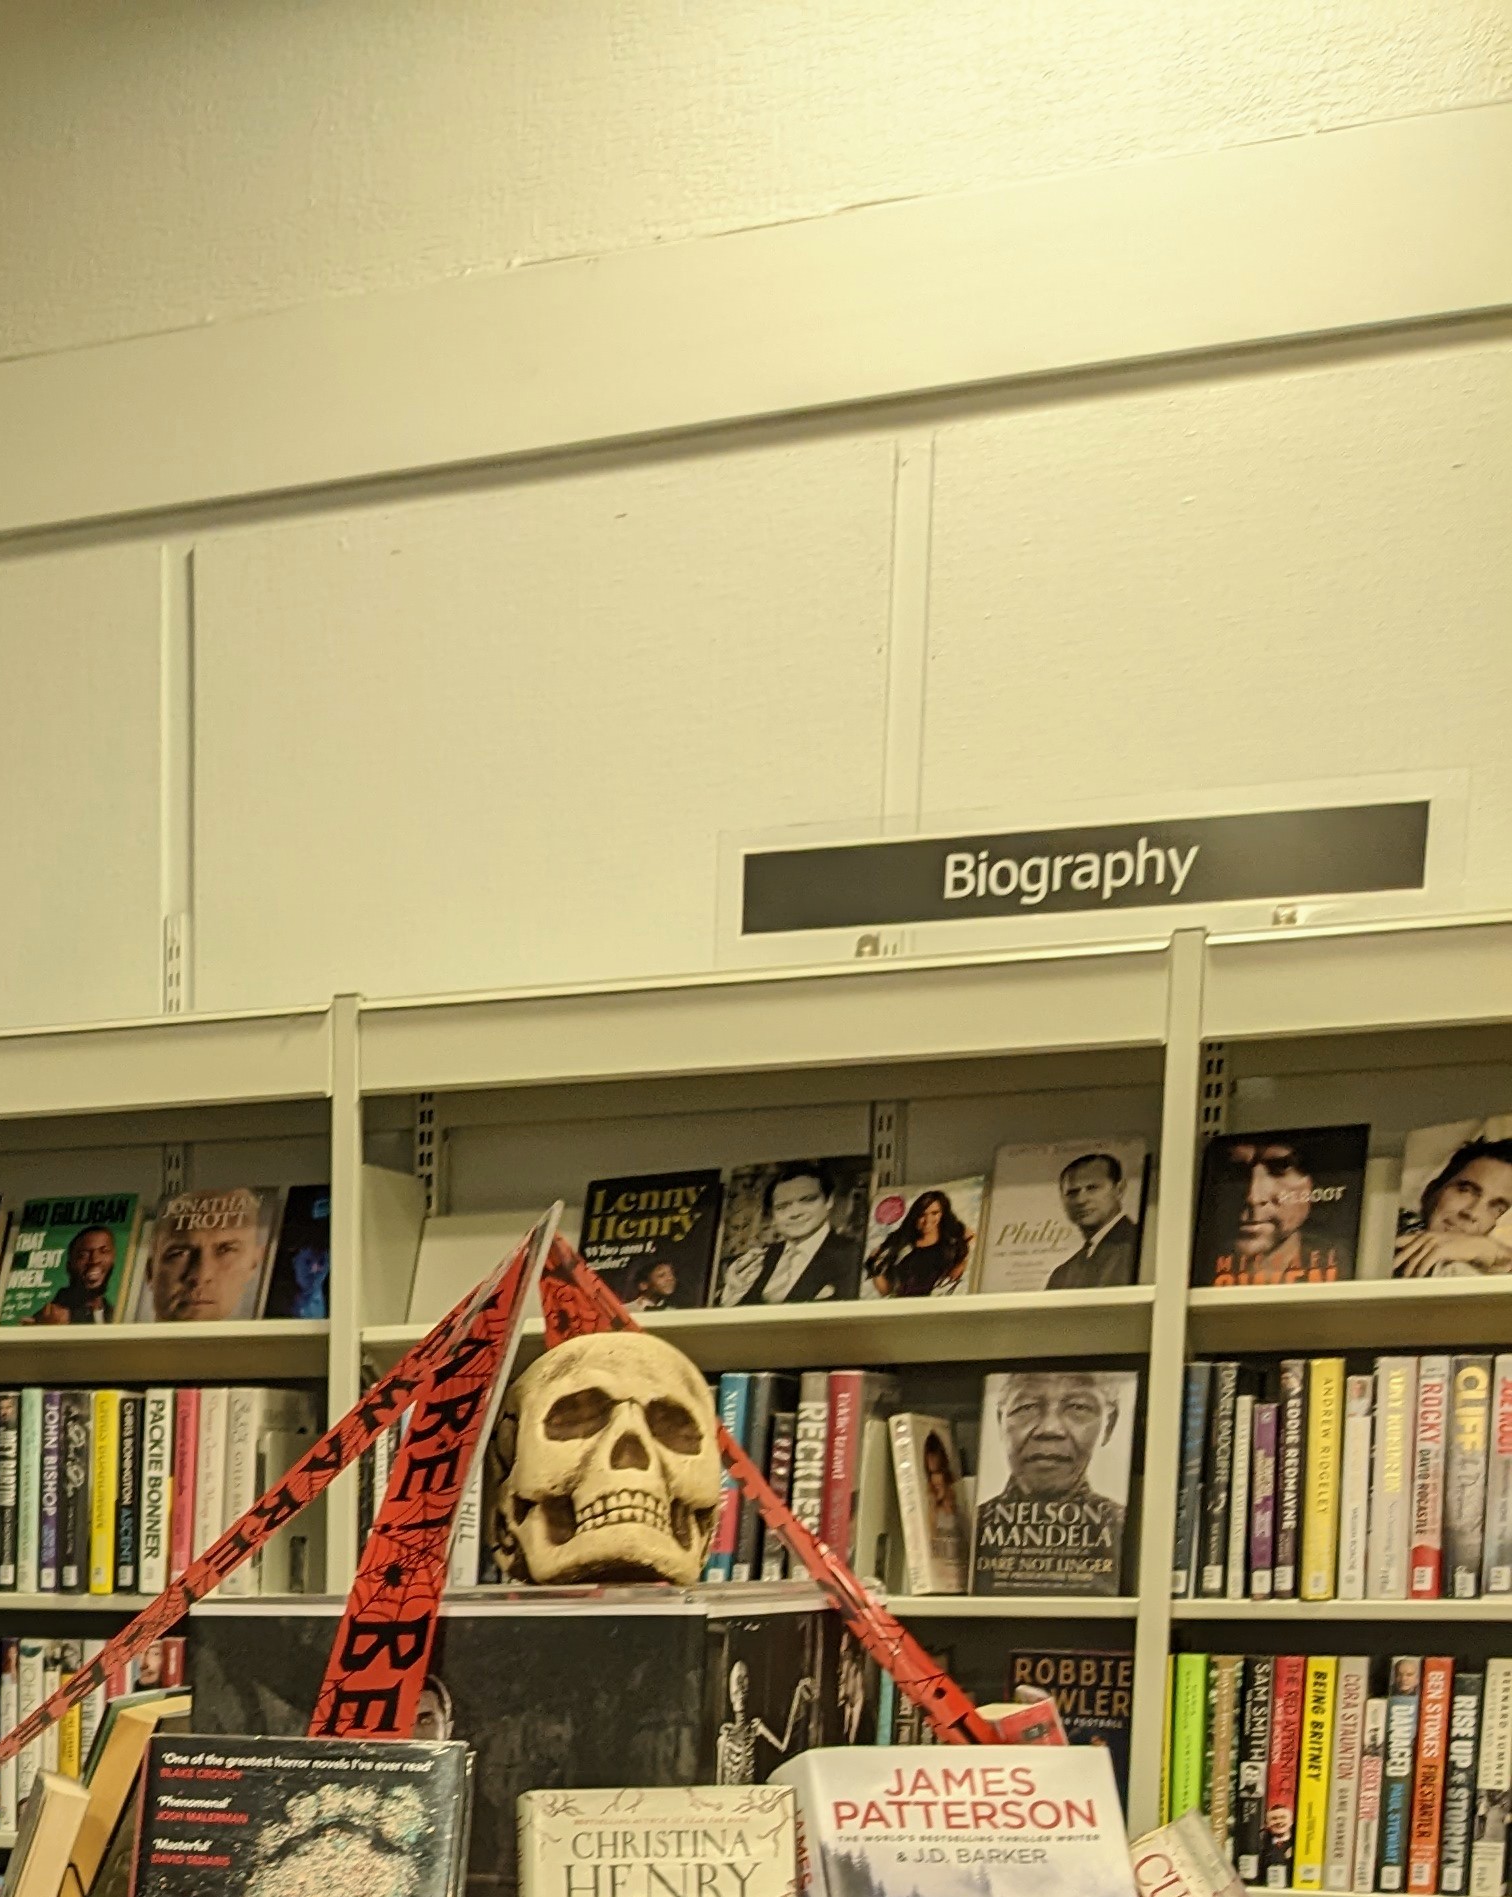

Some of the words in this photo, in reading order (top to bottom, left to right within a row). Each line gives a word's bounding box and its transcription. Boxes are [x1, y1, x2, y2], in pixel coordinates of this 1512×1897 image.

[944, 837, 1200, 903] Biography
[50, 1199, 129, 1226] GILLIGAN
[592, 1185, 706, 1214] Lenny
[16, 1232, 47, 1250] THAT
[174, 1213, 245, 1231] TROTT
[589, 1212, 702, 1242] Henry
[995, 1219, 1073, 1248] Philip
[44, 1403, 59, 1449] JOHN
[122, 1402, 135, 1437] CHRIS
[1285, 1399, 1300, 1443] EDDIE
[1321, 1378, 1333, 1439] ANDREW
[1420, 1383, 1442, 1444] ROCKY
[1454, 1366, 1488, 1451] CLIFF
[148, 1399, 165, 1472] PACKIE
[120, 1438, 133, 1504] BONINGTON
[1317, 1447, 1331, 1515] RIDGELEY
[1417, 1449, 1431, 1479] DAVID
[42, 1455, 58, 1516] BISHOP
[1282, 1448, 1299, 1530] REDMAYNE
[144, 1475, 161, 1558] BONNER
[458, 1501, 476, 1543] HILL
[994, 1502, 1106, 1524] NELSON
[1415, 1483, 1430, 1536] ROCASTLE
[119, 1507, 131, 1563] ASCENT
[980, 1524, 1112, 1547] MANDELA
[977, 1557, 1015, 1571] DARE
[1019, 1557, 1054, 1571] NOT
[1056, 1557, 1113, 1572] LINGER
[1015, 1657, 1132, 1686] ROBBIE
[1253, 1663, 1269, 1703] SAM
[1286, 1664, 1301, 1687] THE
[1342, 1674, 1361, 1710] CORA
[1427, 1669, 1445, 1699] BEN
[1284, 1691, 1299, 1717] RED
[1312, 1671, 1328, 1715] BEING
[1499, 1671, 1512, 1728] BERNARD
[1248, 1706, 1266, 1761] SMITH
[1422, 1703, 1442, 1758] STOKES
[1453, 1695, 1477, 1736] RISE
[1278, 1718, 1296, 1796] APPRENTICE
[1306, 1720, 1324, 1782] BRITNEY
[1338, 1713, 1360, 1780] STAUNTON
[1386, 1704, 1414, 1777] DAMAGED
[1450, 1741, 1471, 1768] UP
[1494, 1735, 1509, 1787] SUMNER
[884, 1767, 1037, 1798] JAMES
[1337, 1788, 1349, 1812] GAME
[1386, 1783, 1403, 1811] PAUL
[1415, 1764, 1438, 1839] FIRESTARTER
[833, 1799, 1098, 1831] PATTERSON
[571, 1829, 751, 1859] CHRISTINA
[864, 1834, 916, 1843] WORLD'S
[919, 1835, 993, 1843] BESTSELLING
[998, 1834, 1052, 1843] THRILLER
[1056, 1834, 1101, 1842] WRITER
[896, 1851, 907, 1863] &
[913, 1848, 950, 1864] J.D.
[957, 1848, 1048, 1864] BARKER
[1334, 1816, 1347, 1859] CHANGER
[1383, 1813, 1400, 1863] STEWART
